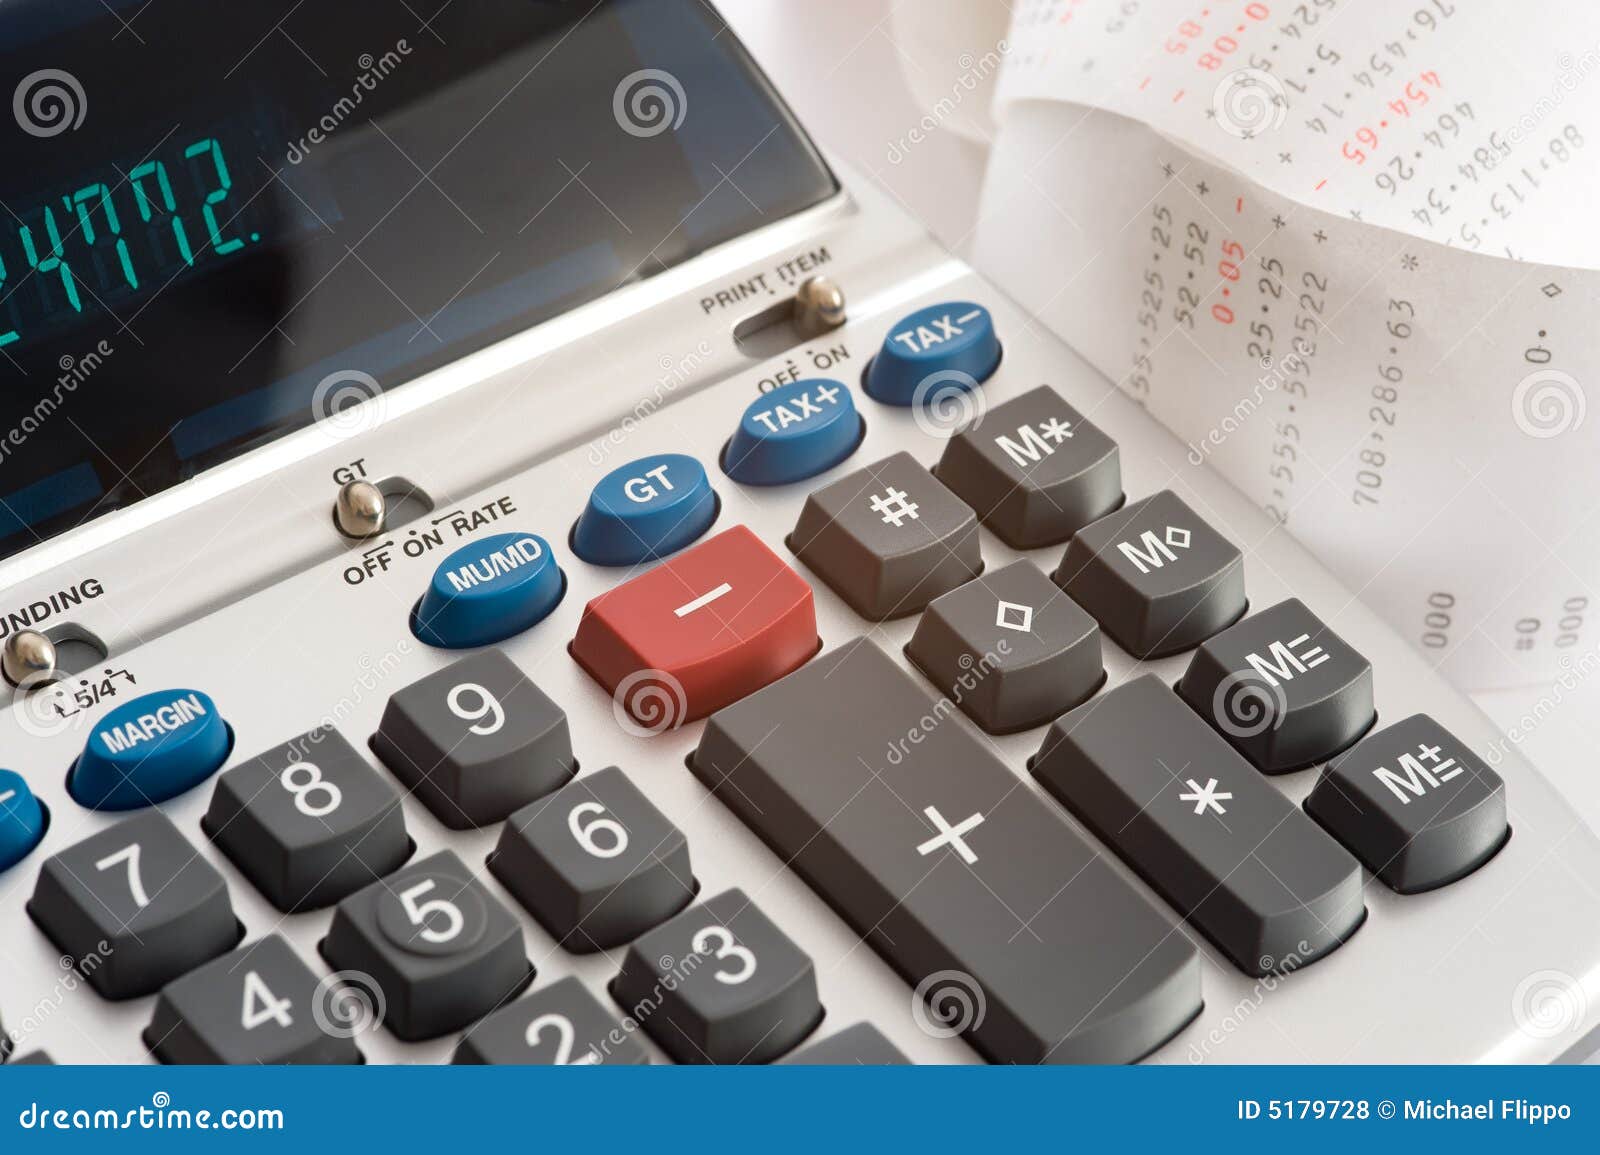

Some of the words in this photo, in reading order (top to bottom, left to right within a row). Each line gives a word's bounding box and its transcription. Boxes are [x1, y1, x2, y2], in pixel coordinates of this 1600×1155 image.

[1341, 69, 1443, 165] 454.65
[1374, 101, 1476, 196] 464.26
[1444, 124, 1585, 249] 88,113.5
[701, 274, 768, 315] PRINT
[776, 246, 833, 282] ITEM
[1173, 222, 1209, 330] 52.52
[1211, 239, 1245, 325] 0.05
[1247, 256, 1285, 360] 25.25
[758, 364, 802, 395] OFF
[813, 344, 851, 371] ON
[752, 385, 840, 433] TAX+
[1353, 299, 1415, 505] 708,286.63
[332, 458, 369, 487] GT
[623, 464, 677, 505] GT
[869, 486, 921, 528] #
[343, 550, 392, 586] OFF
[402, 528, 444, 558] ON
[450, 496, 518, 537] RATE
[100, 693, 207, 755] MARGIN
[446, 682, 506, 736] 9
[280, 761, 343, 818] 8
[567, 802, 629, 859] 6
[96, 843, 151, 908] 7
[399, 878, 465, 943] 5
[692, 925, 757, 986] 3
[241, 971, 294, 1031] 4
[525, 1013, 600, 1065] 2
